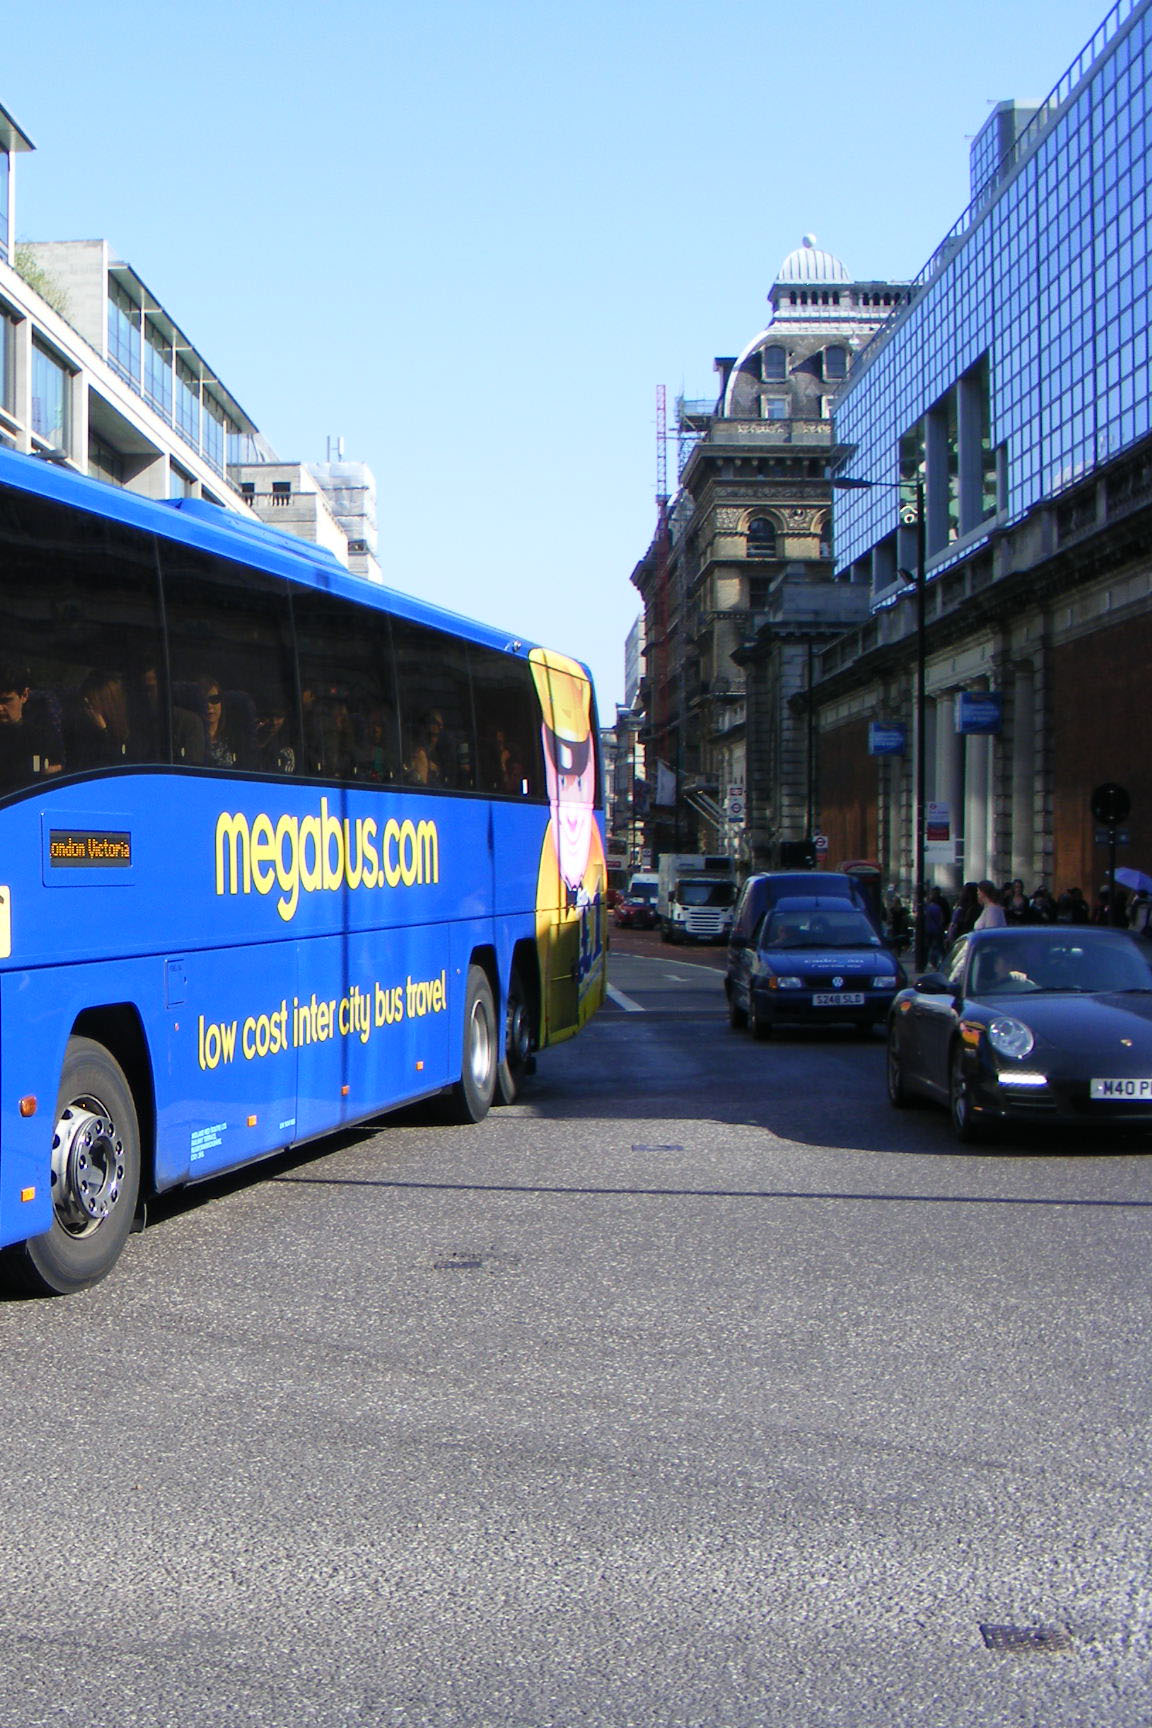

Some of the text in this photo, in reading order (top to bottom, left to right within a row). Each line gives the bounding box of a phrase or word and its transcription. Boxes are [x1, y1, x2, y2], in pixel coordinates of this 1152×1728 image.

[49, 837, 131, 859] ondon Victoria
[215, 796, 440, 922] megabus.com
[198, 969, 447, 1071] low cost inter city bus travel
[1139, 1080, 1152, 1096] P
